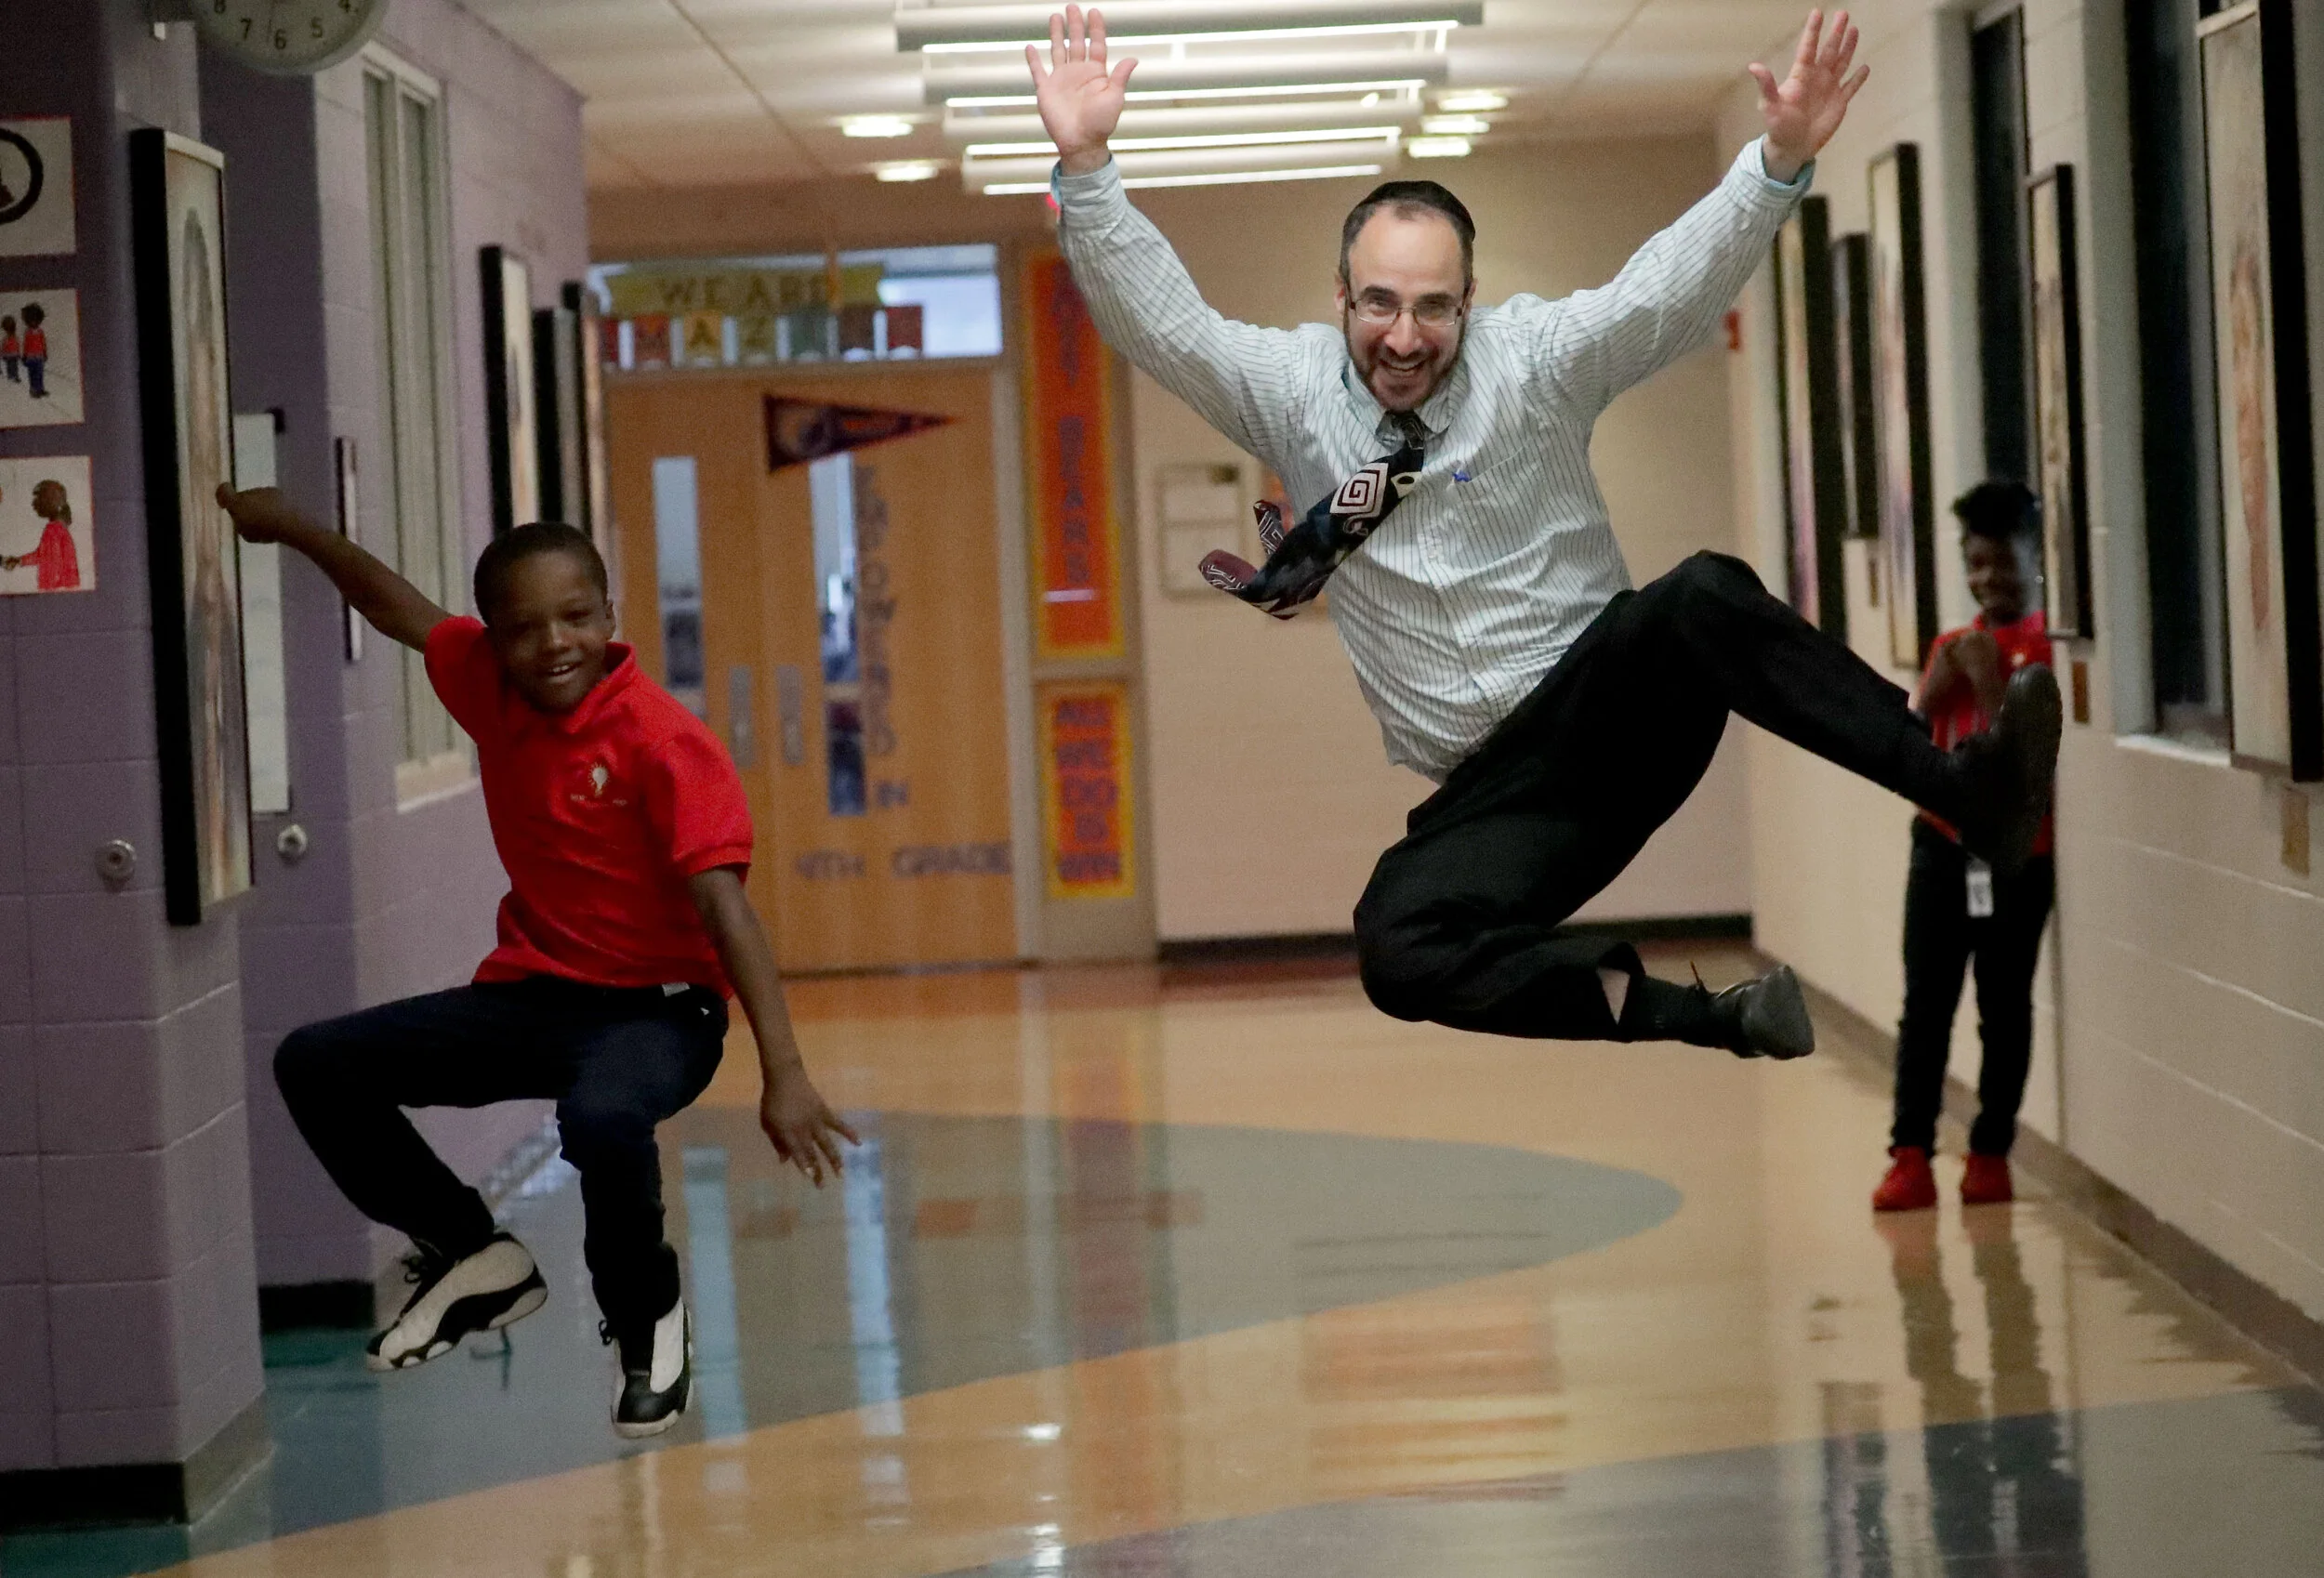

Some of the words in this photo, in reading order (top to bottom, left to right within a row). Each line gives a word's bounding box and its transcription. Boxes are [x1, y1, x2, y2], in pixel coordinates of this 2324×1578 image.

[240, 18, 252, 40] 7
[310, 16, 324, 39] 5
[274, 28, 287, 50] 6
[658, 275, 720, 306] WE
